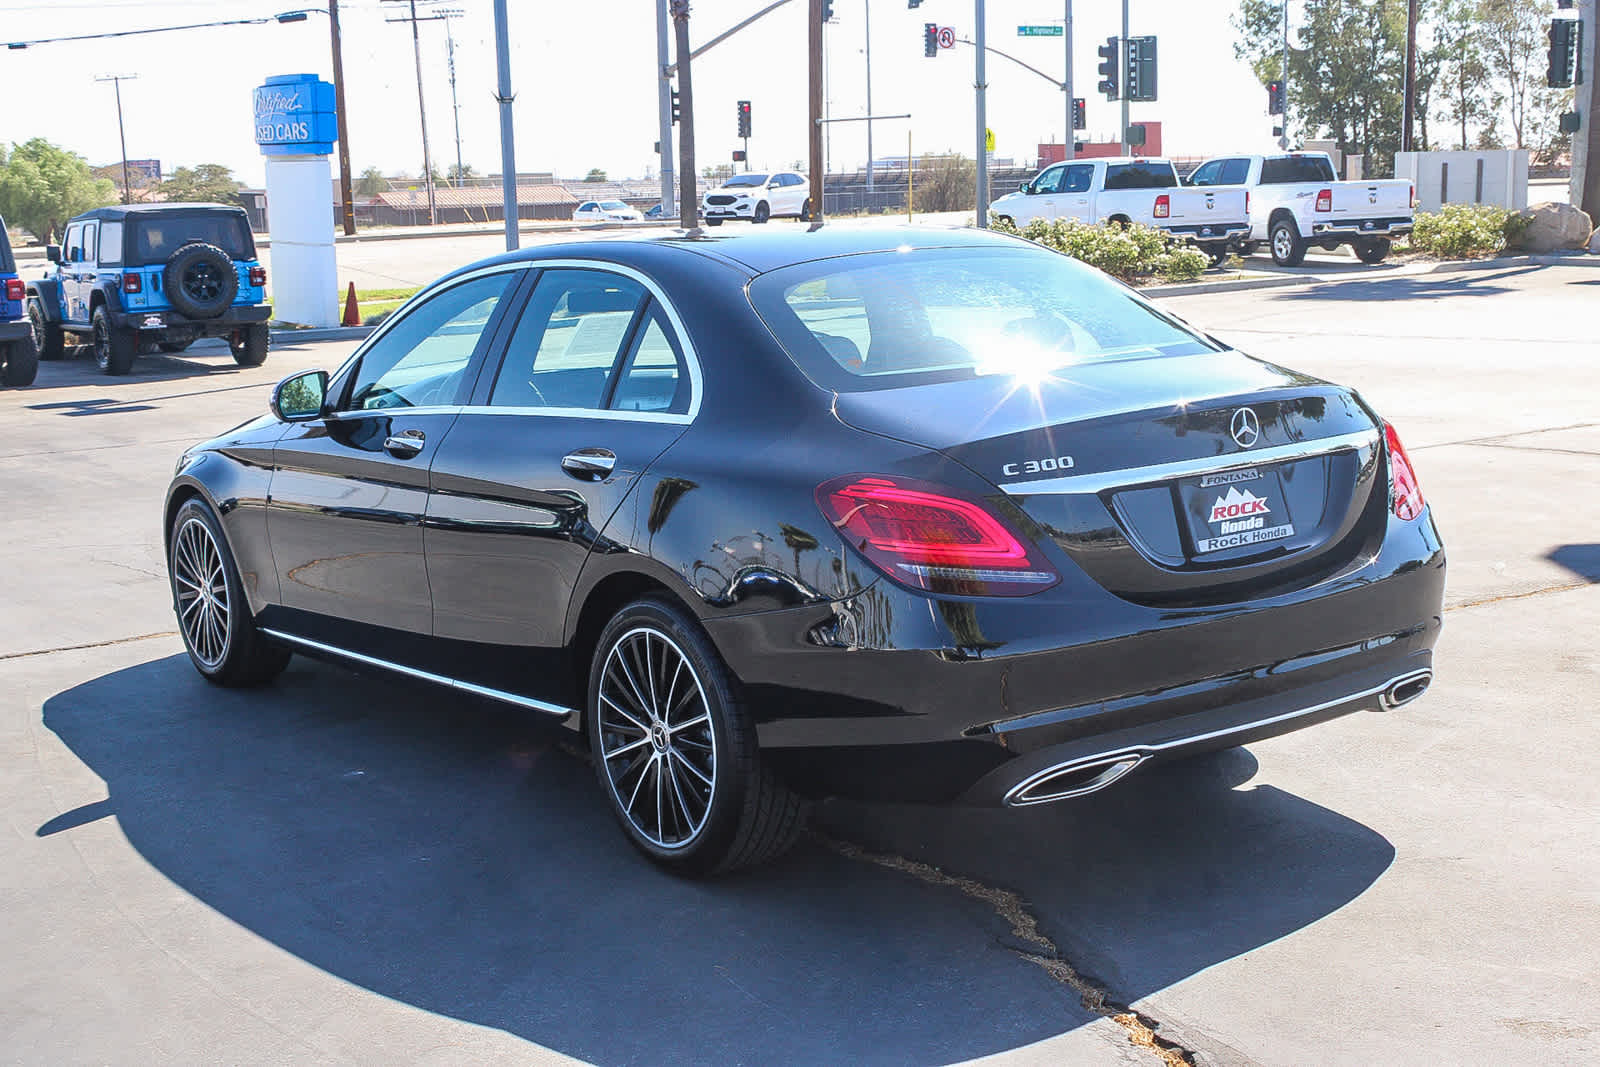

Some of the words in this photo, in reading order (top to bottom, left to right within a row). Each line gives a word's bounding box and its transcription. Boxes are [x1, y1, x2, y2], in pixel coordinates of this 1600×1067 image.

[277, 122, 308, 140] CARS
[1003, 463, 1020, 476] C
[1024, 456, 1074, 473] 300
[1207, 470, 1257, 485] FONTANA
[1213, 500, 1265, 520] ROCK
[1221, 517, 1264, 535] Honda
[1208, 535, 1249, 549] Rock
[1252, 528, 1287, 541] Honda
